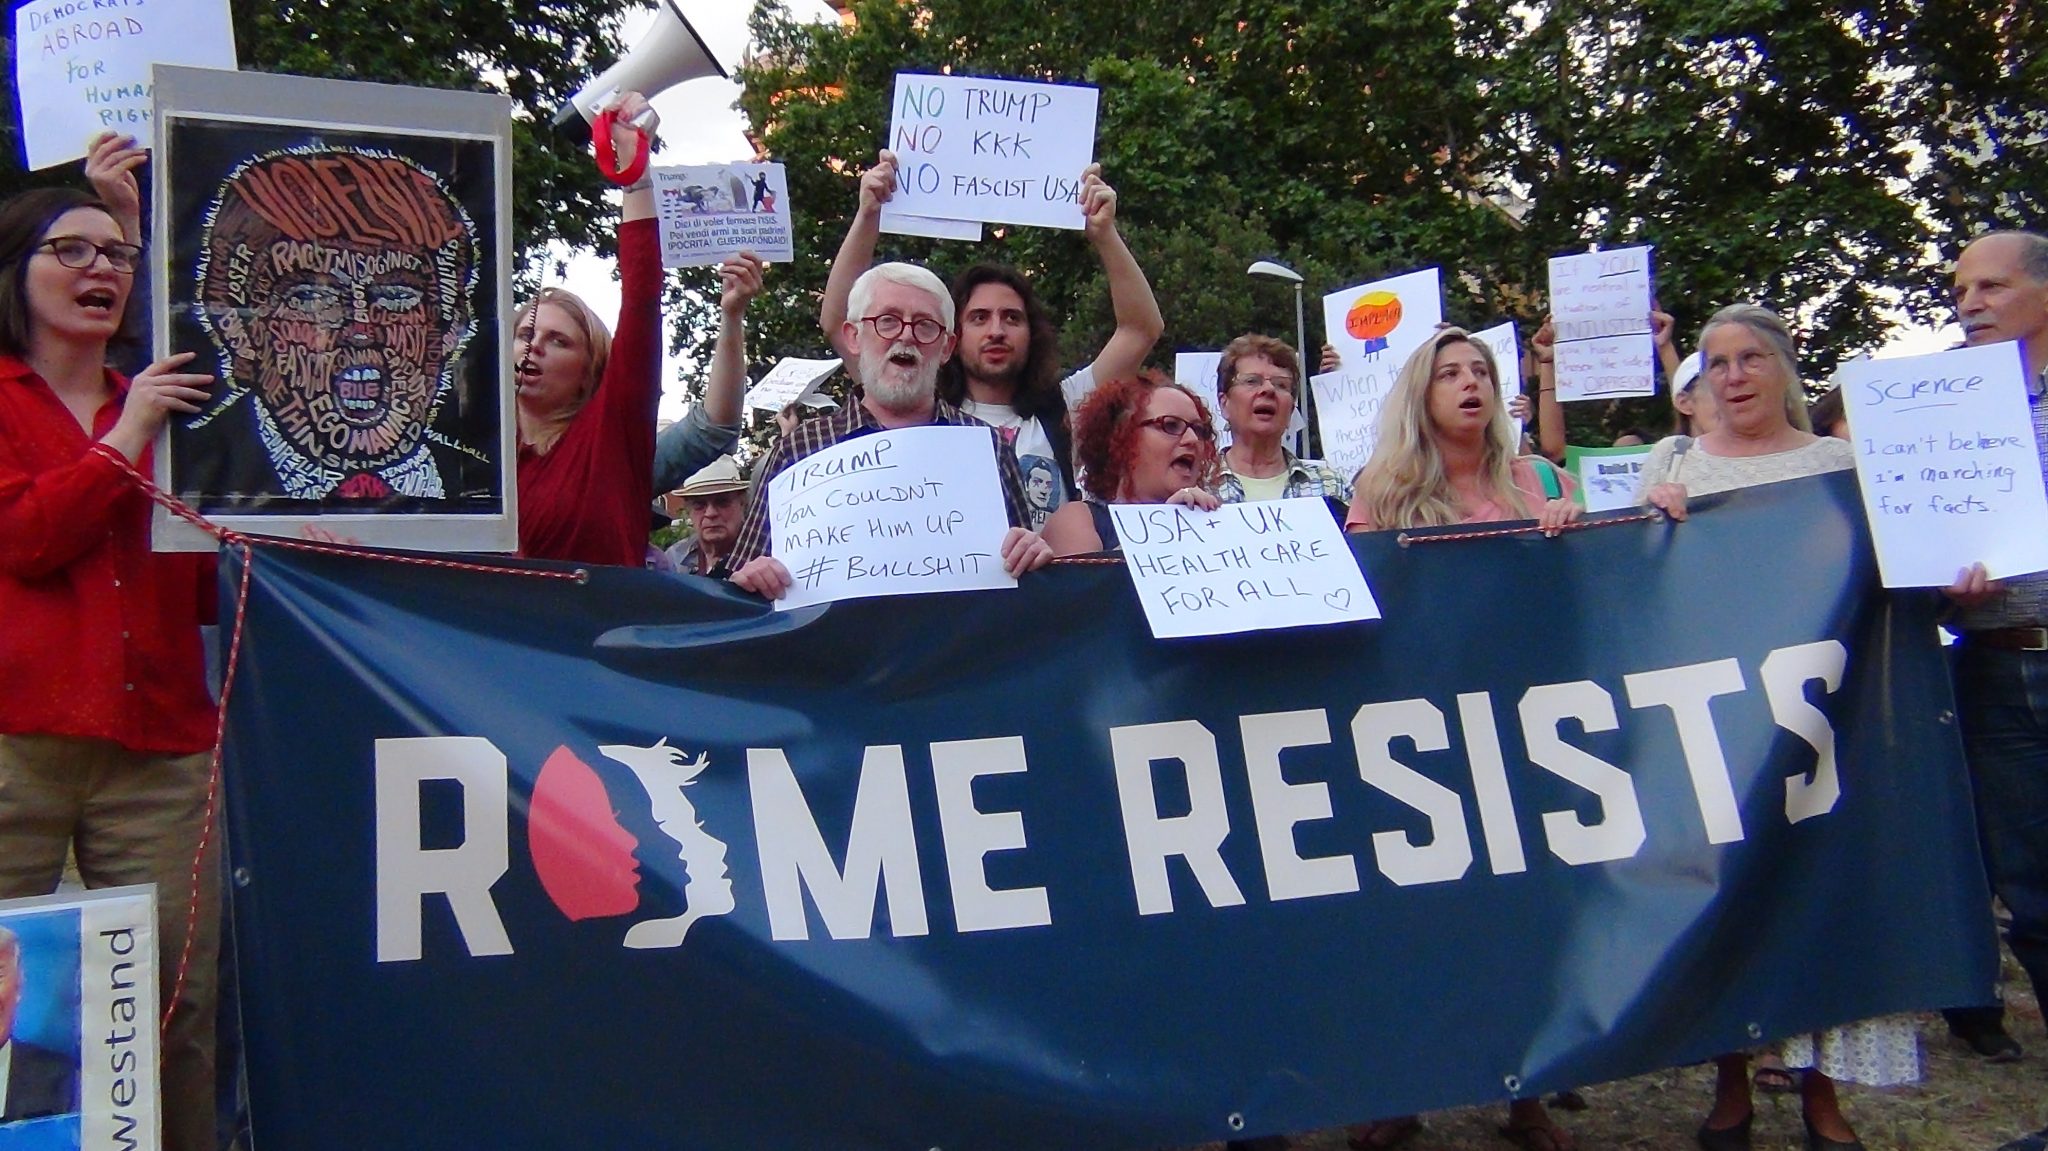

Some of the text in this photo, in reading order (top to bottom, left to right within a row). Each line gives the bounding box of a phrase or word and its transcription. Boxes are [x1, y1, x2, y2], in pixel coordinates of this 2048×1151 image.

[40, 17, 143, 59] ABROAD
[86, 84, 152, 103] HUMA
[901, 84, 1052, 124] NO TRUMP
[98, 109, 152, 126] RIGH
[895, 124, 1033, 159] NO KKK
[952, 175, 1035, 198] FASCIST
[1043, 175, 1081, 205] USA
[685, 229, 710, 239] vendi
[711, 227, 729, 237] armi
[703, 217, 725, 226] voler
[228, 243, 255, 305] LOSER
[271, 240, 339, 276] RACIST
[335, 249, 422, 282] MISOGYNIST
[385, 322, 428, 367] NASTY
[275, 390, 324, 457] THIN
[320, 421, 422, 471] SKINNED
[308, 393, 350, 449] EGO
[348, 399, 411, 455] MANIAC
[1864, 438, 1876, 455] I
[1881, 434, 1937, 455] can't
[778, 439, 892, 493] TRUMP
[1920, 461, 2016, 492] marching
[825, 477, 944, 508] COULDN'T
[1879, 495, 1912, 515] for
[784, 524, 855, 553] MAKE
[926, 510, 965, 536] UP
[1115, 505, 1294, 545] USA + UK
[847, 552, 993, 581] BULLSHIT
[1133, 539, 1330, 578] HEALTH CARE
[1160, 577, 1313, 615] FOR ALL
[1110, 639, 1848, 916] RESISTS
